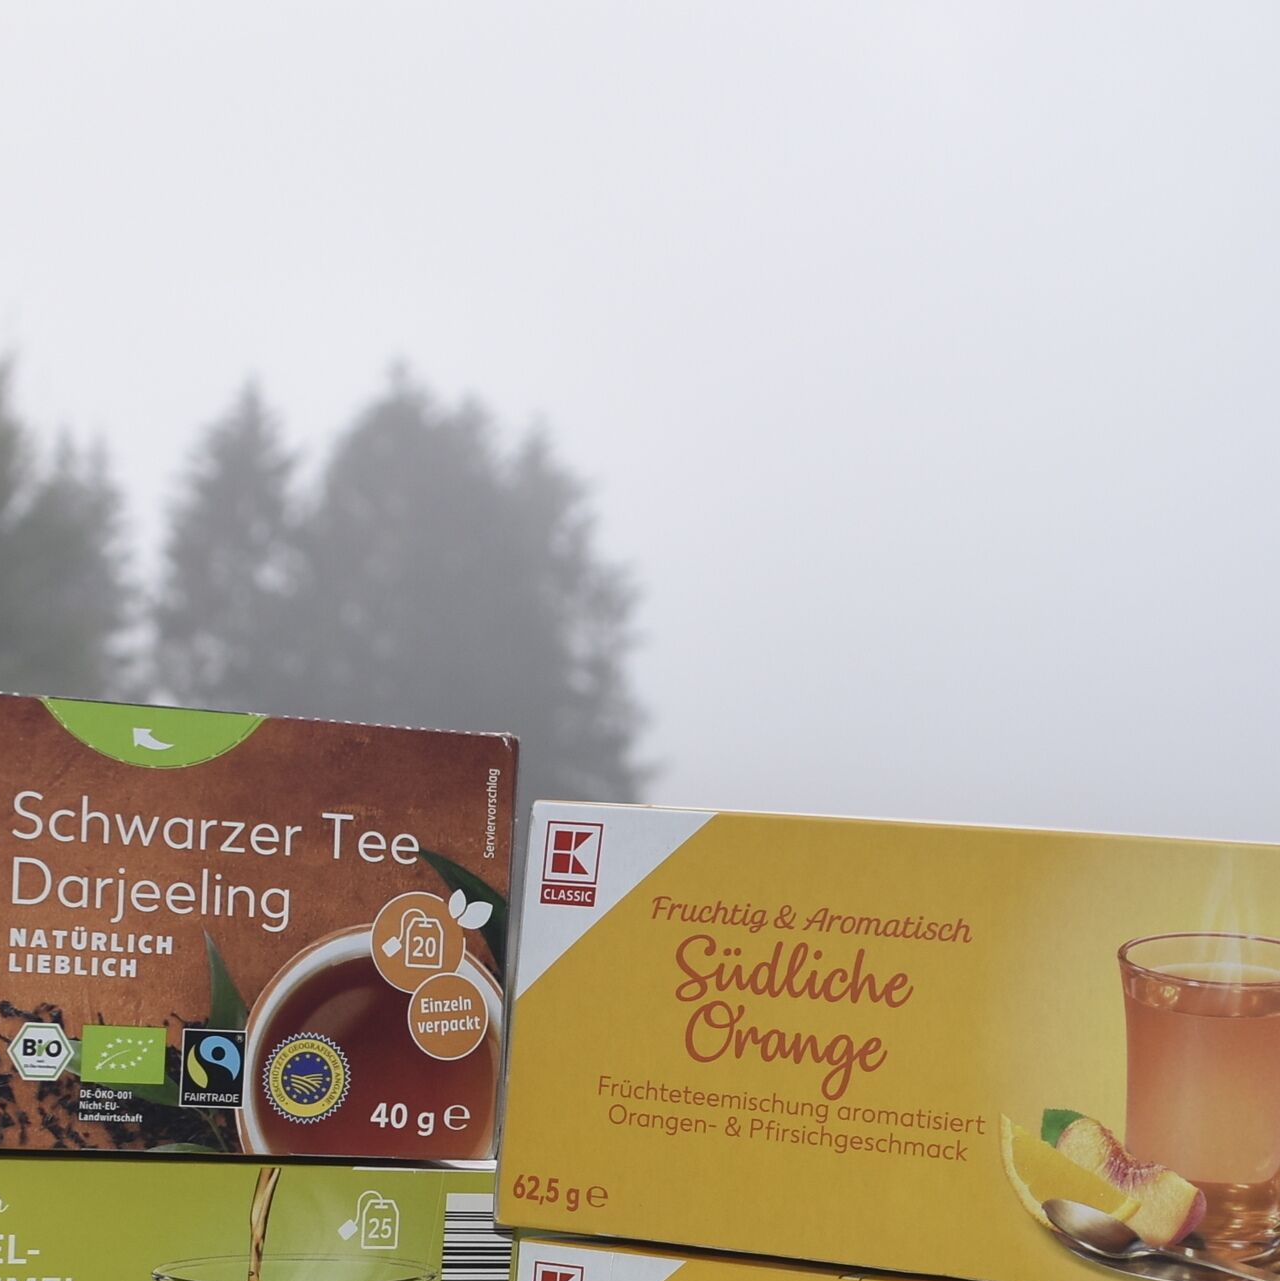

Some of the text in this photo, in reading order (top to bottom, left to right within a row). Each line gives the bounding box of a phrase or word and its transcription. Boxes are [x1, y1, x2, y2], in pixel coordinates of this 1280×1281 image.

[11, 790, 420, 865] Schwarzer Tee
[483, 767, 501, 859] Serviervorschlag
[11, 856, 290, 933] Darjeeling
[543, 887, 593, 904] CLASSIC
[651, 896, 973, 945] Fruchtig & Aromatisch
[8, 925, 174, 955] NATÜRLICH
[412, 937, 436, 958] 20
[8, 953, 137, 978] LIEBLICH
[675, 933, 914, 1008] Südliche
[420, 996, 472, 1014] Einzeln
[417, 1016, 481, 1036] verpackt
[684, 1000, 888, 1101] Orange
[79, 1088, 132, 1100] DE-ÖKO-001
[79, 1101, 120, 1112] Nicht-EU-
[184, 1091, 240, 1104] FAIRTRADE
[597, 1075, 987, 1135] Früchteteemischung aromatisiert
[78, 1112, 143, 1124] Landwirtschaft
[370, 1102, 435, 1136] 40 g
[608, 1103, 969, 1162] Orangen- & Pfirsichgeschmack
[513, 1174, 580, 1212] 62,5 g
[368, 1218, 392, 1239] 25
